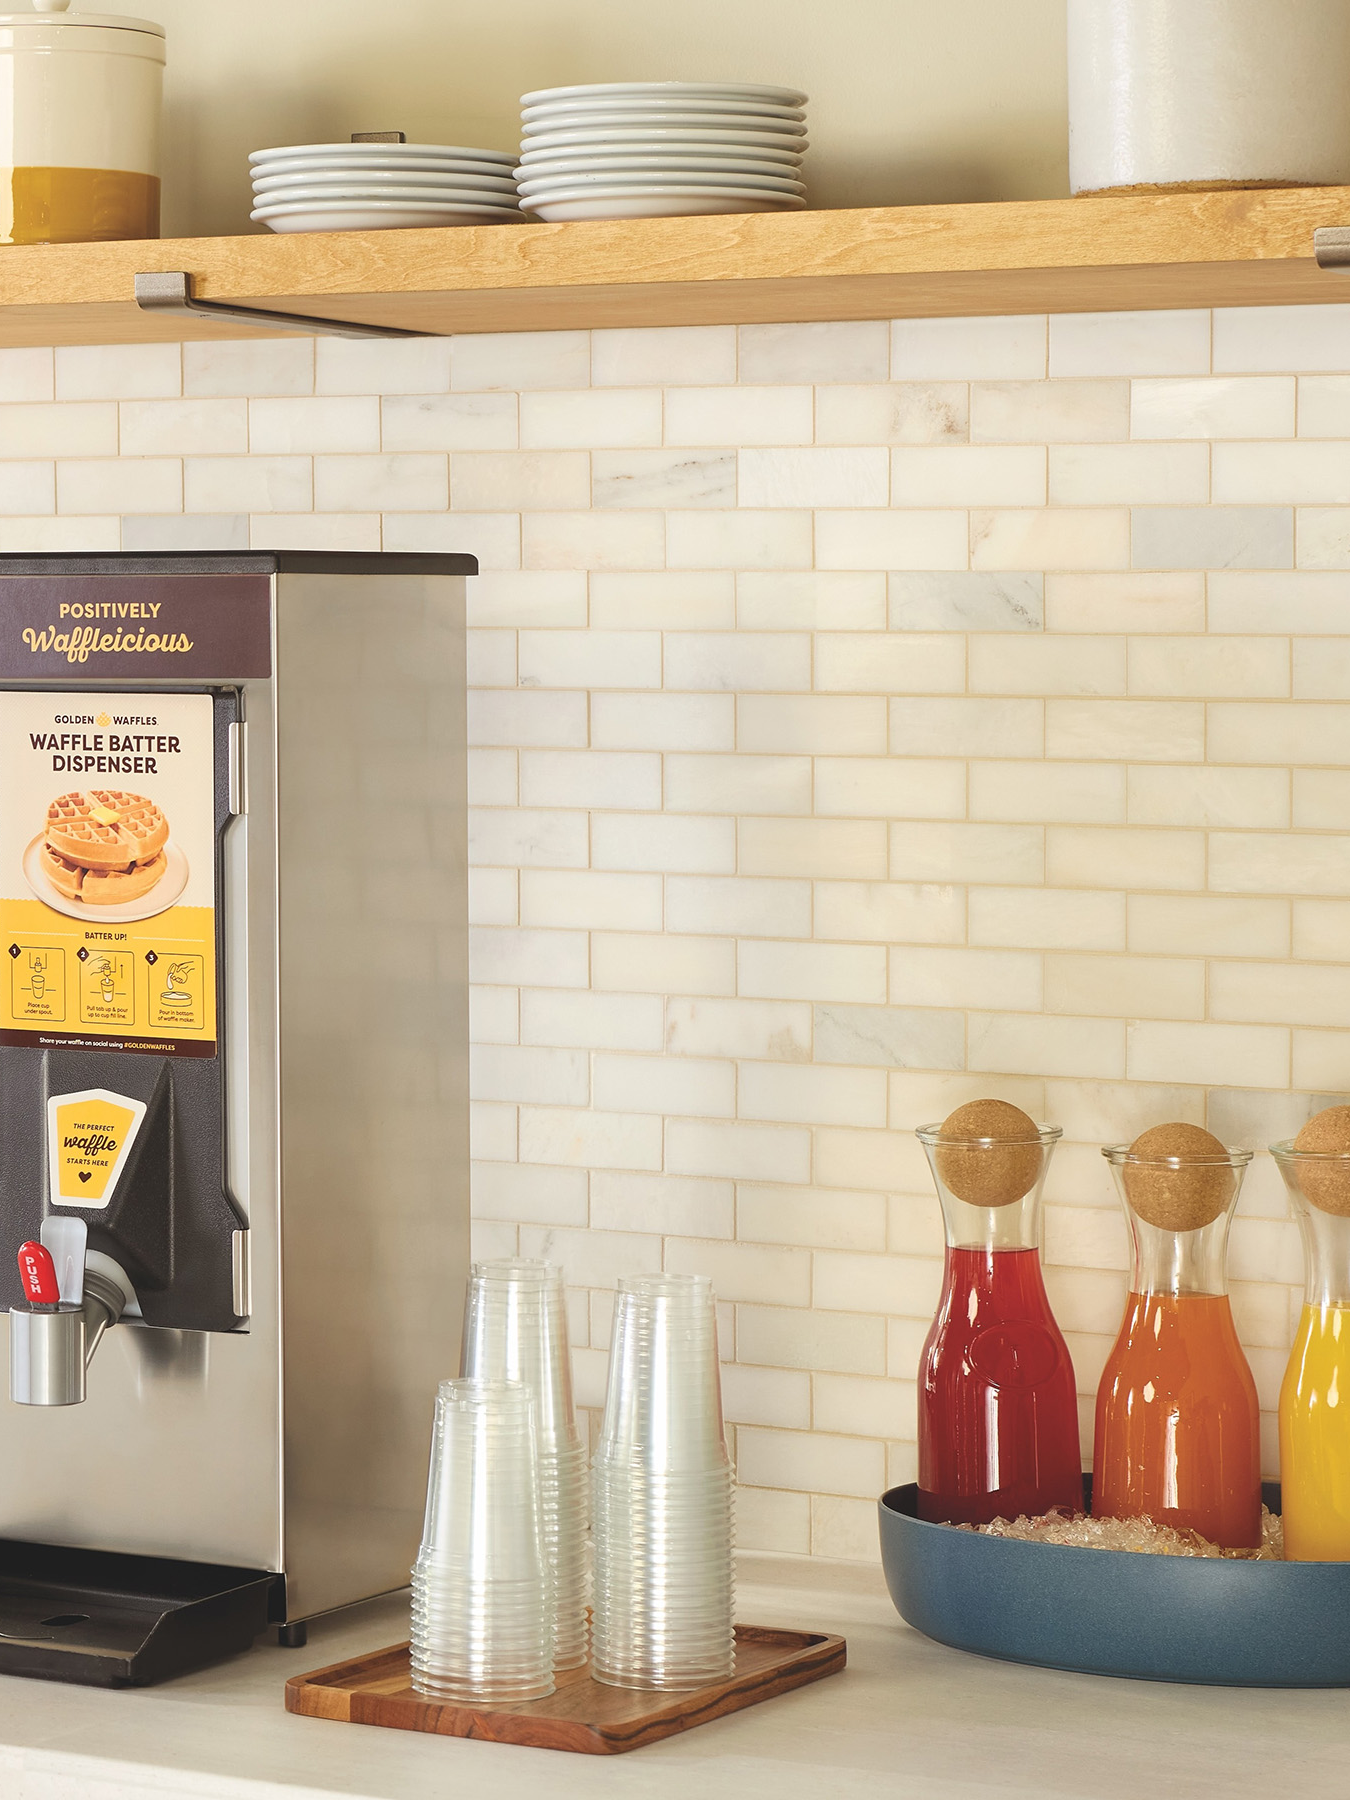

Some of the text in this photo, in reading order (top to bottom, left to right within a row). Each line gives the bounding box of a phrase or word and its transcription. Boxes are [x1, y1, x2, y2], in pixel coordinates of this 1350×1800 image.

[59, 602, 161, 619] POSITIVELY
[22, 625, 194, 663] Waffleicious
[54, 715, 157, 725] GOLDEN WAFFLES
[30, 733, 181, 753] WAFFLE BATTER
[53, 755, 158, 774] DISPENSER
[85, 932, 127, 941] BATTER UP!
[109, 1041, 123, 1049] using
[124, 1042, 175, 1051] #GOLDENWAFFLES
[64, 1134, 117, 1156] waffle
[25, 1256, 41, 1294] PUSH
